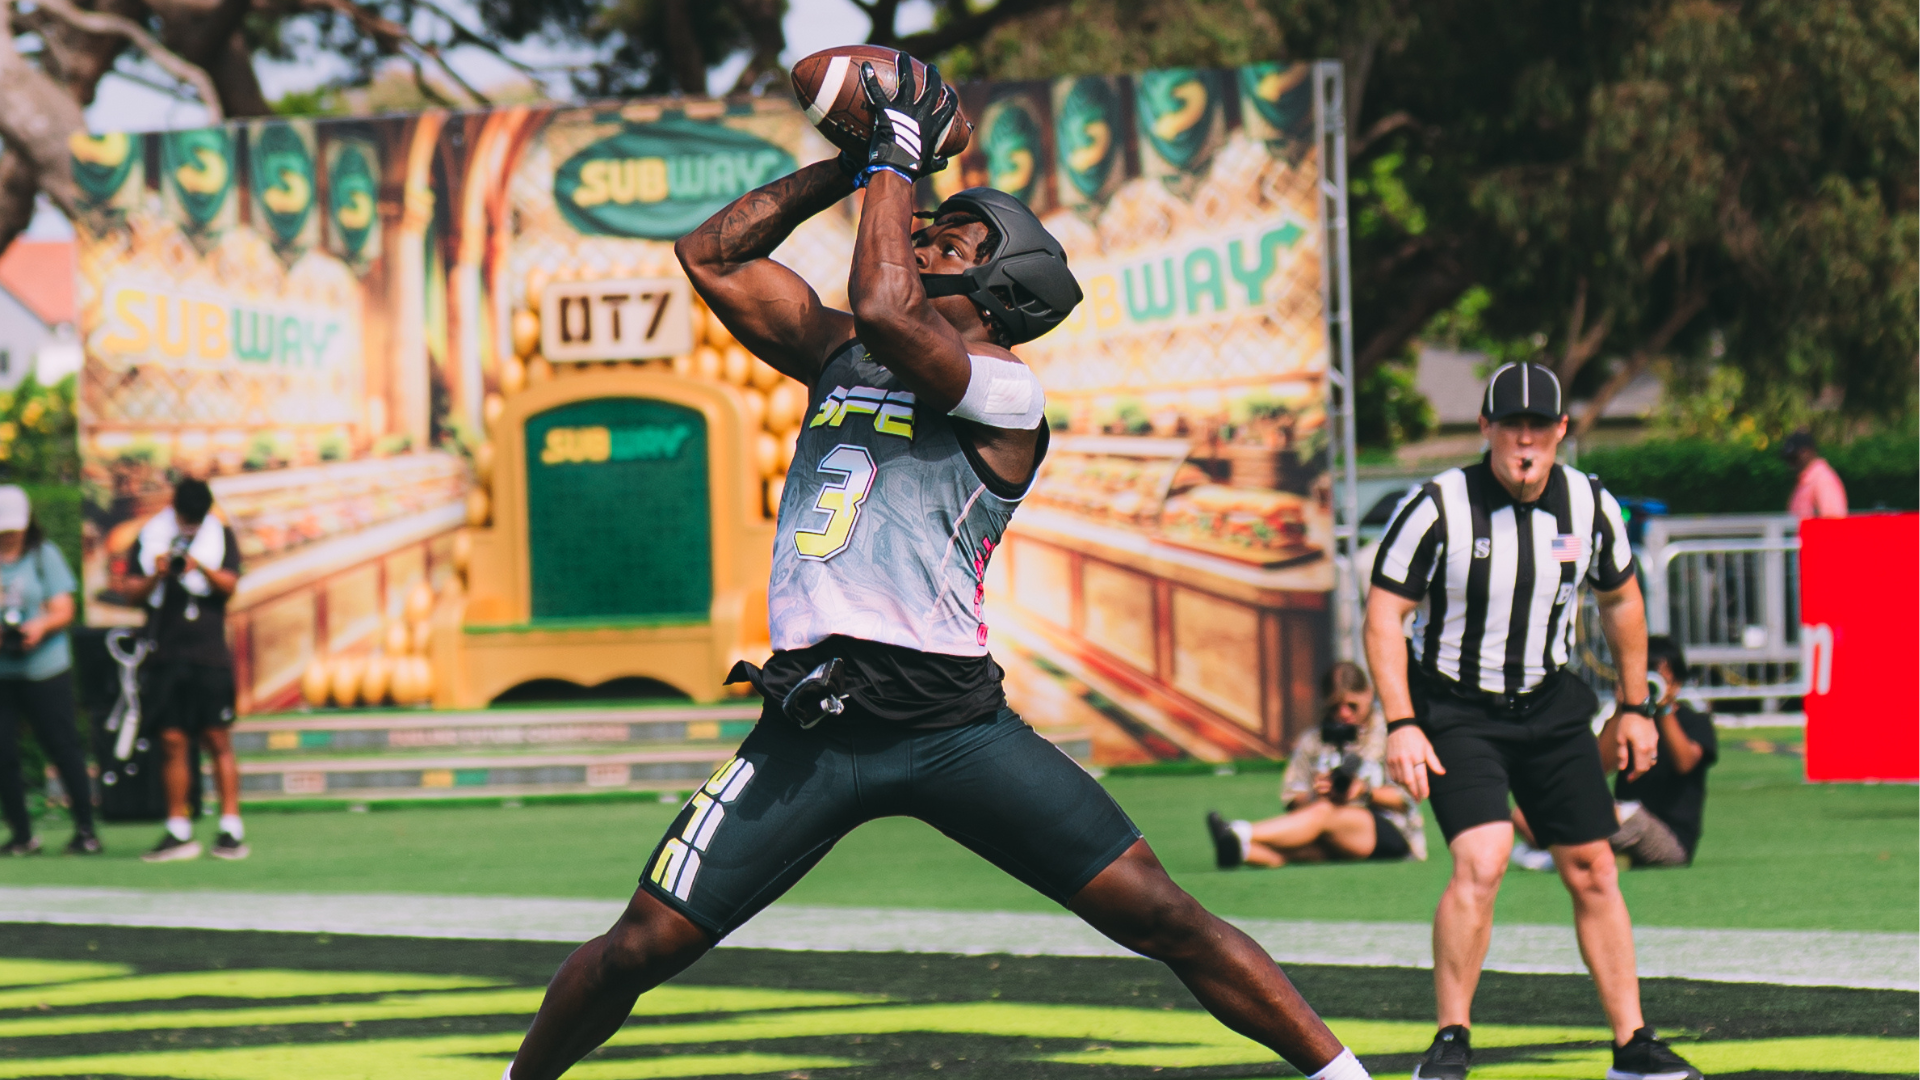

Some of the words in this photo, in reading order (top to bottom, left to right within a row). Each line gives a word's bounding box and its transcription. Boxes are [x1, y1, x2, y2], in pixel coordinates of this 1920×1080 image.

[573, 150, 780, 208] SUBWAY
[103, 289, 341, 367] SUBWAY
[541, 424, 691, 464] SUBWAY
[793, 443, 878, 562] 3
[1473, 537, 1491, 559] S
